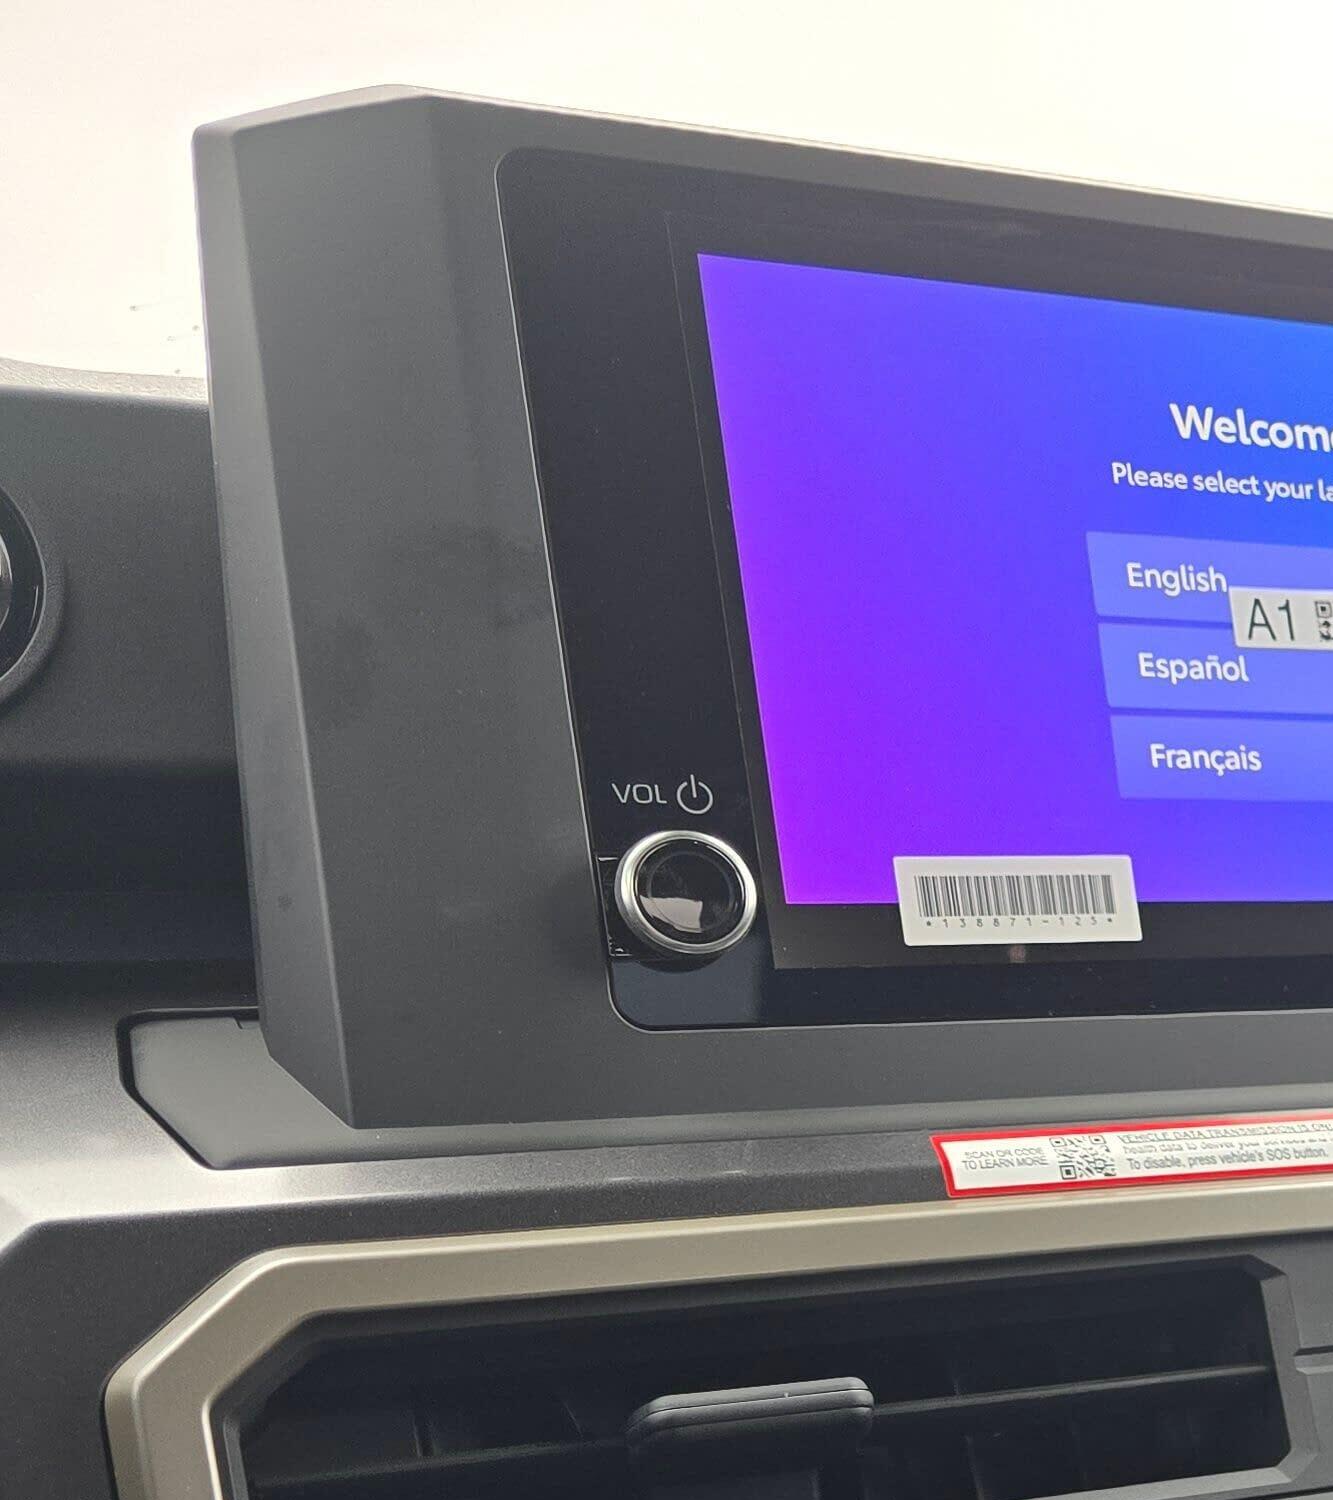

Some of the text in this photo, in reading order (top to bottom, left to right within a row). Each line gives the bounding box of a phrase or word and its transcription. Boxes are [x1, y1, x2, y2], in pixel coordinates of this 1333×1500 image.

[1112, 462, 1188, 490] Please
[1193, 472, 1260, 496] select
[1264, 481, 1313, 502] your
[1126, 562, 1228, 597] English
[1248, 598, 1296, 641] A1
[1139, 652, 1249, 686] Español
[1150, 744, 1262, 776] Français
[611, 783, 668, 805] VOL
[962, 1160, 977, 1170] TO
[979, 1159, 1015, 1169] LEARN
[1126, 1157, 1141, 1170] To
[1187, 1155, 1217, 1169] press
[1219, 1150, 1265, 1165] vehicle's
[1266, 1148, 1291, 1161] SOS
